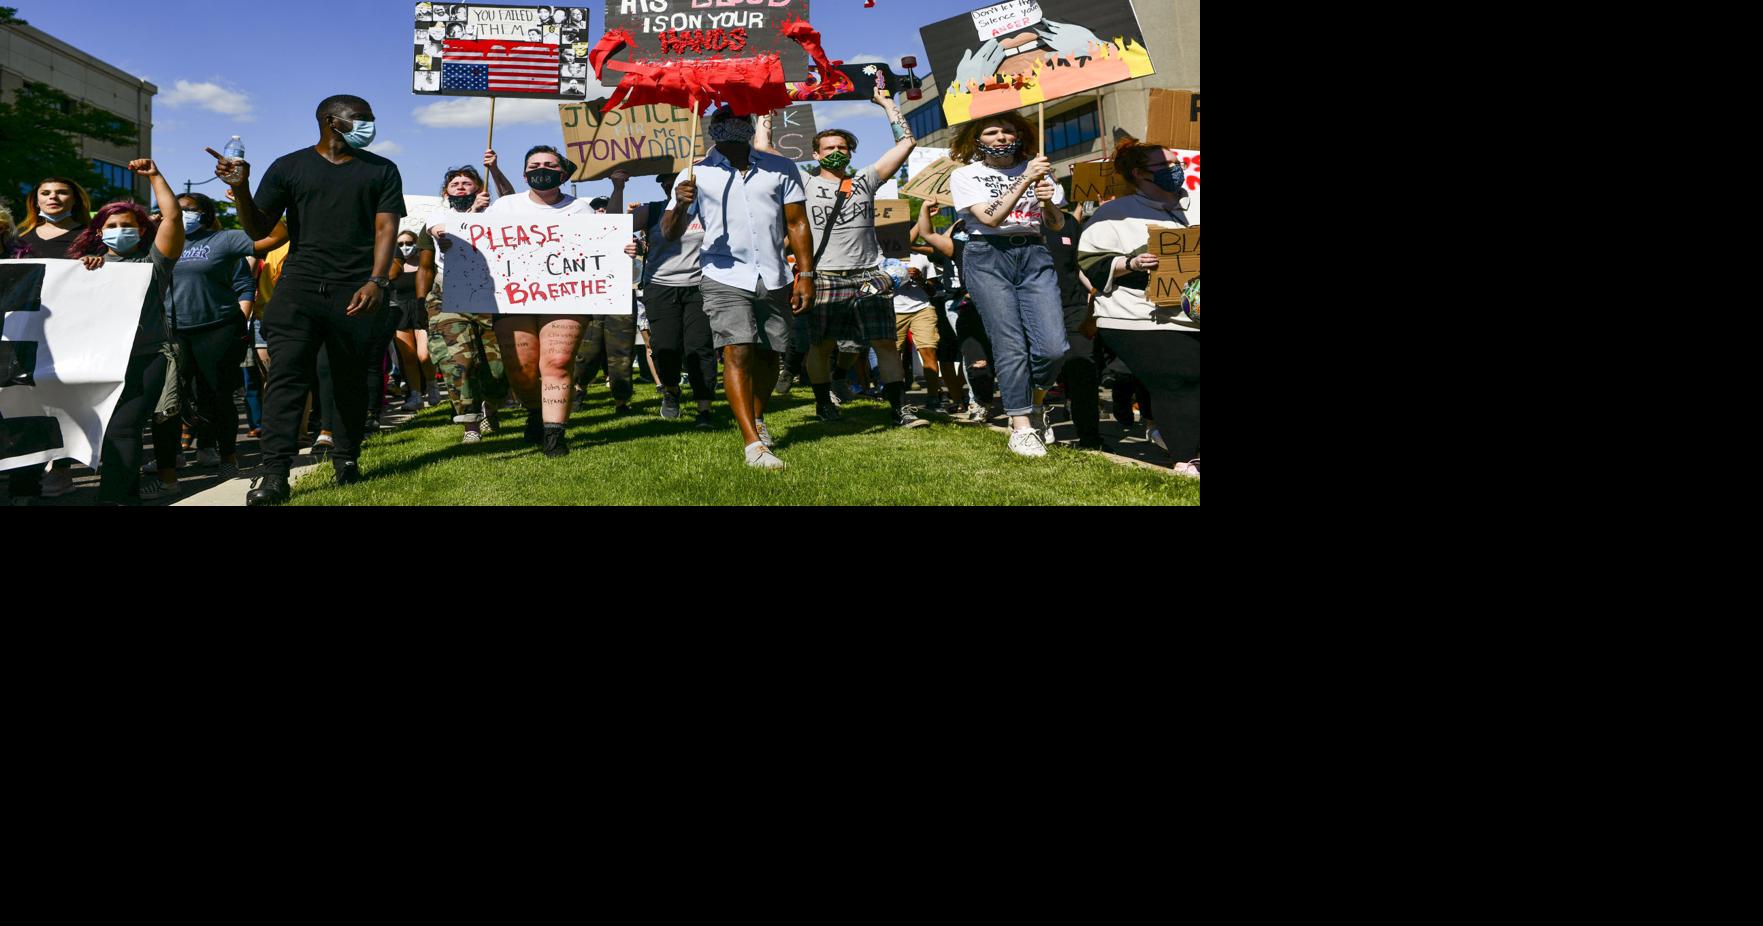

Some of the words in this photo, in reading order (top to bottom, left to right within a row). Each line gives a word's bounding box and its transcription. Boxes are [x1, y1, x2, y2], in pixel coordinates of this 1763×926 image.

[473, 9, 496, 22] YOU
[499, 9, 533, 22] FAILED
[643, 15, 669, 33] IS
[670, 13, 702, 32] ON
[707, 11, 763, 29] YOUR
[992, 17, 1031, 36] ANGER
[658, 27, 748, 54] HANDS
[567, 135, 646, 163] TONY
[506, 260, 511, 277] I
[546, 253, 606, 276] CAN'T
